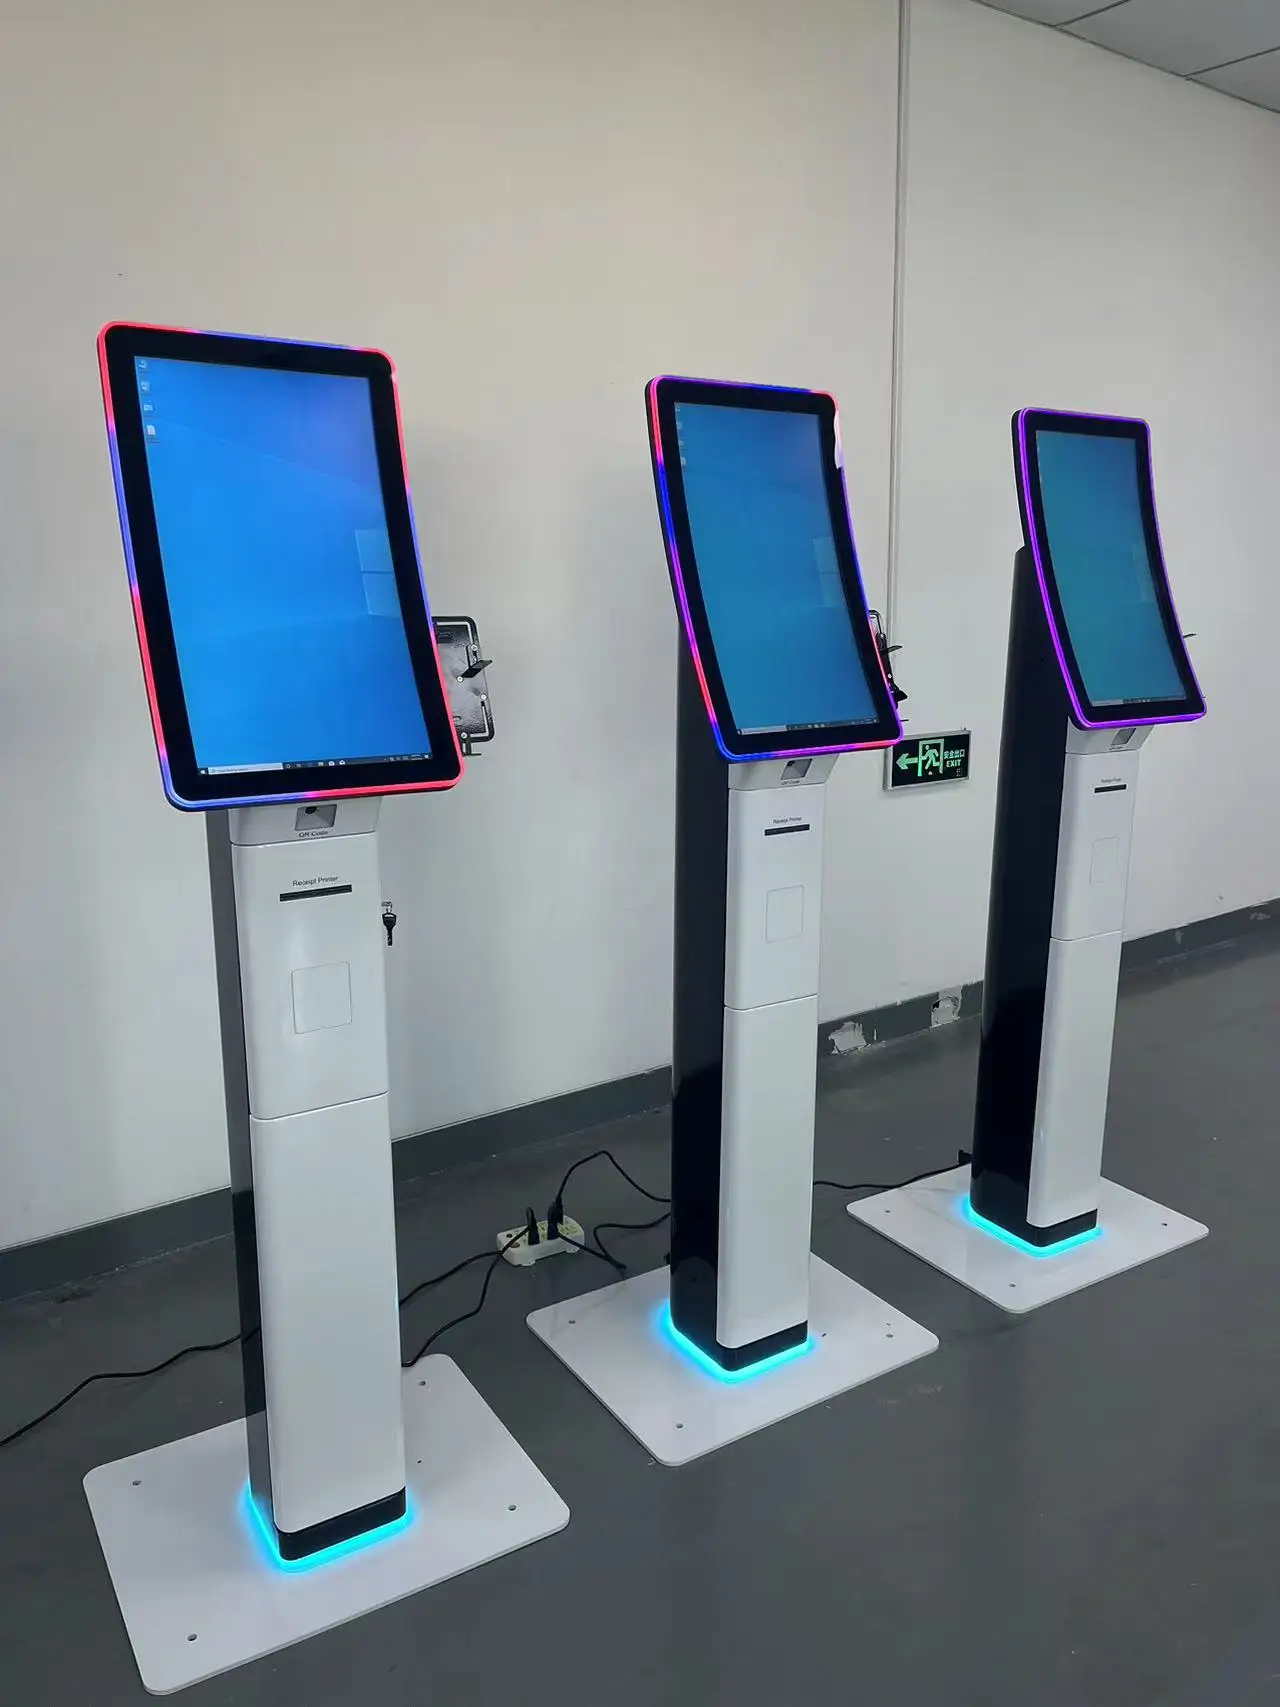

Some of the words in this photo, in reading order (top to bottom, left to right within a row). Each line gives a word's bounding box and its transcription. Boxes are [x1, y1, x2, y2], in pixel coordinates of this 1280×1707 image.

[943, 749, 965, 759] 安全出口
[946, 759, 961, 767] EXIT
[293, 878, 316, 887] Receipt
